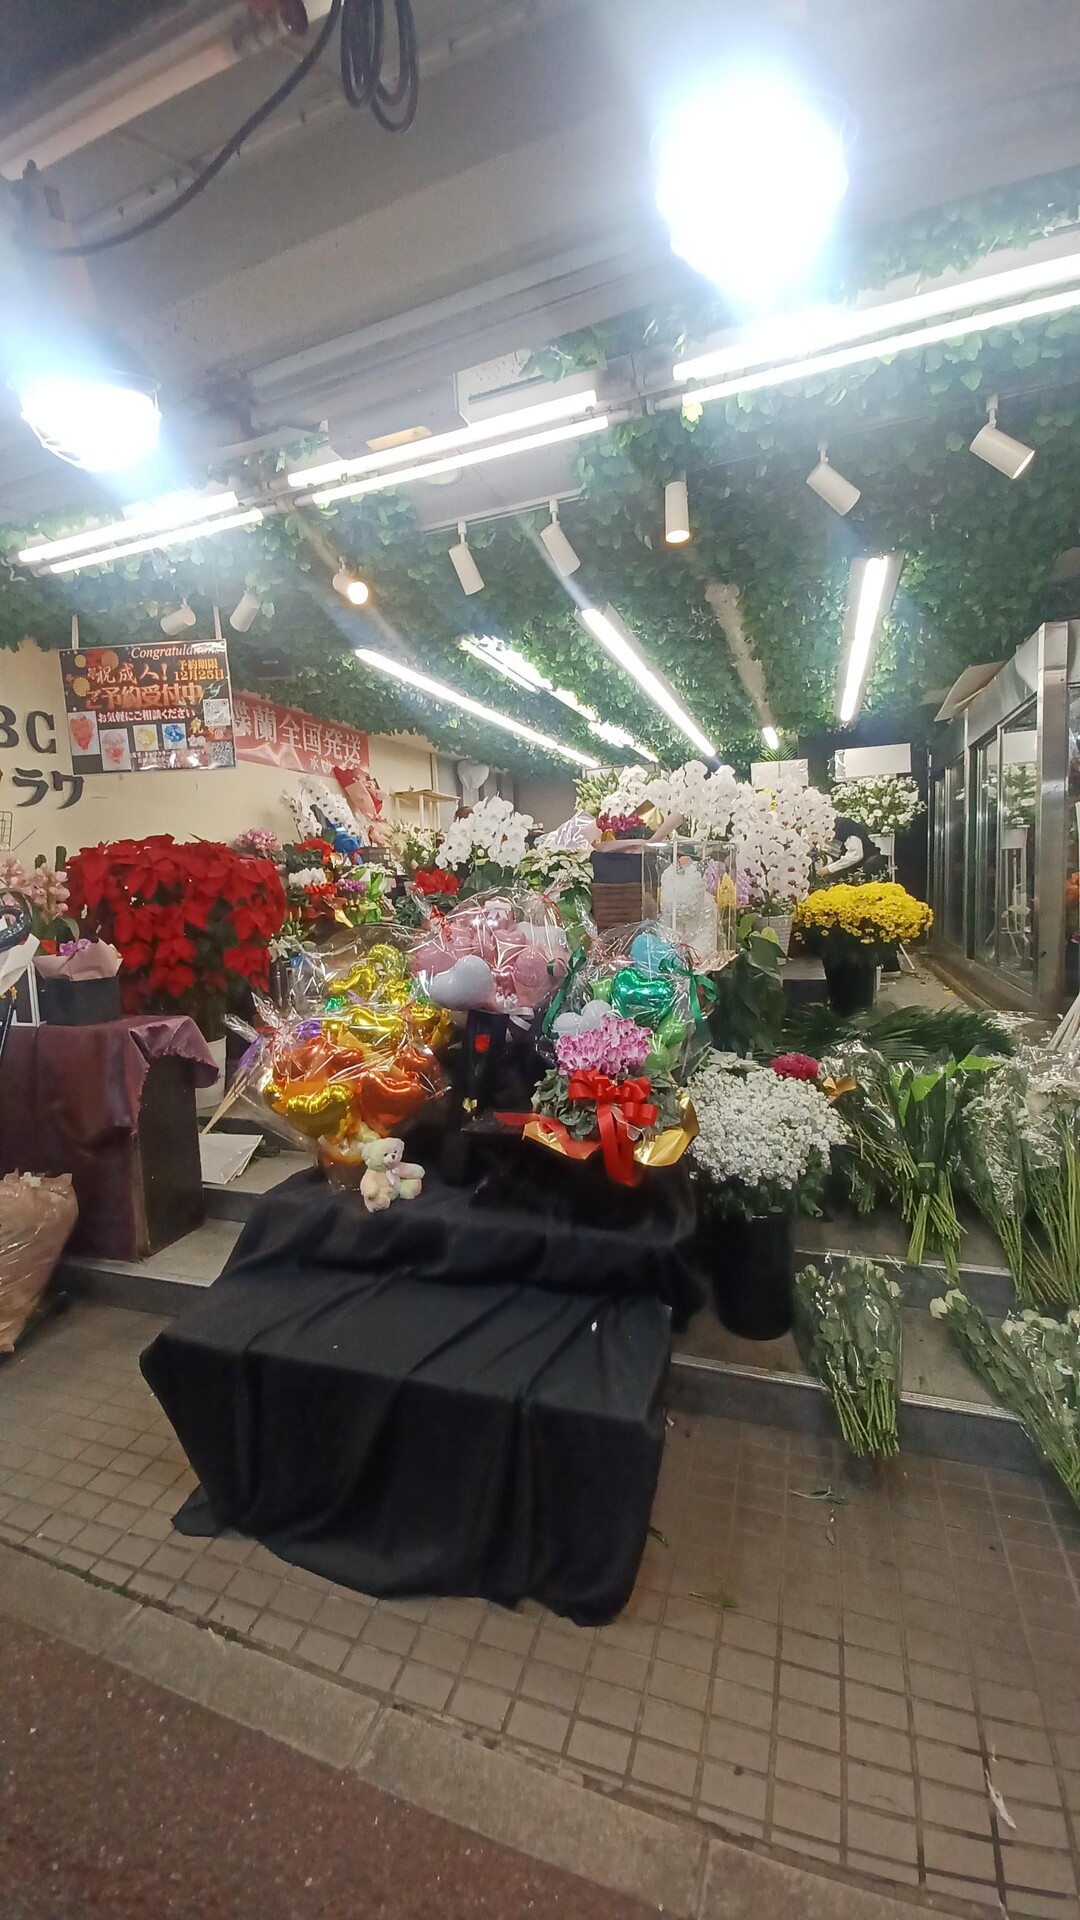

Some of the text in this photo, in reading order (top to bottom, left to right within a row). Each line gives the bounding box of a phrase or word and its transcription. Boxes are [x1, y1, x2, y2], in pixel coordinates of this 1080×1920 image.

[174, 668, 224, 681] 12月25日
[98, 707, 195, 723] お気軽にご相談ください
